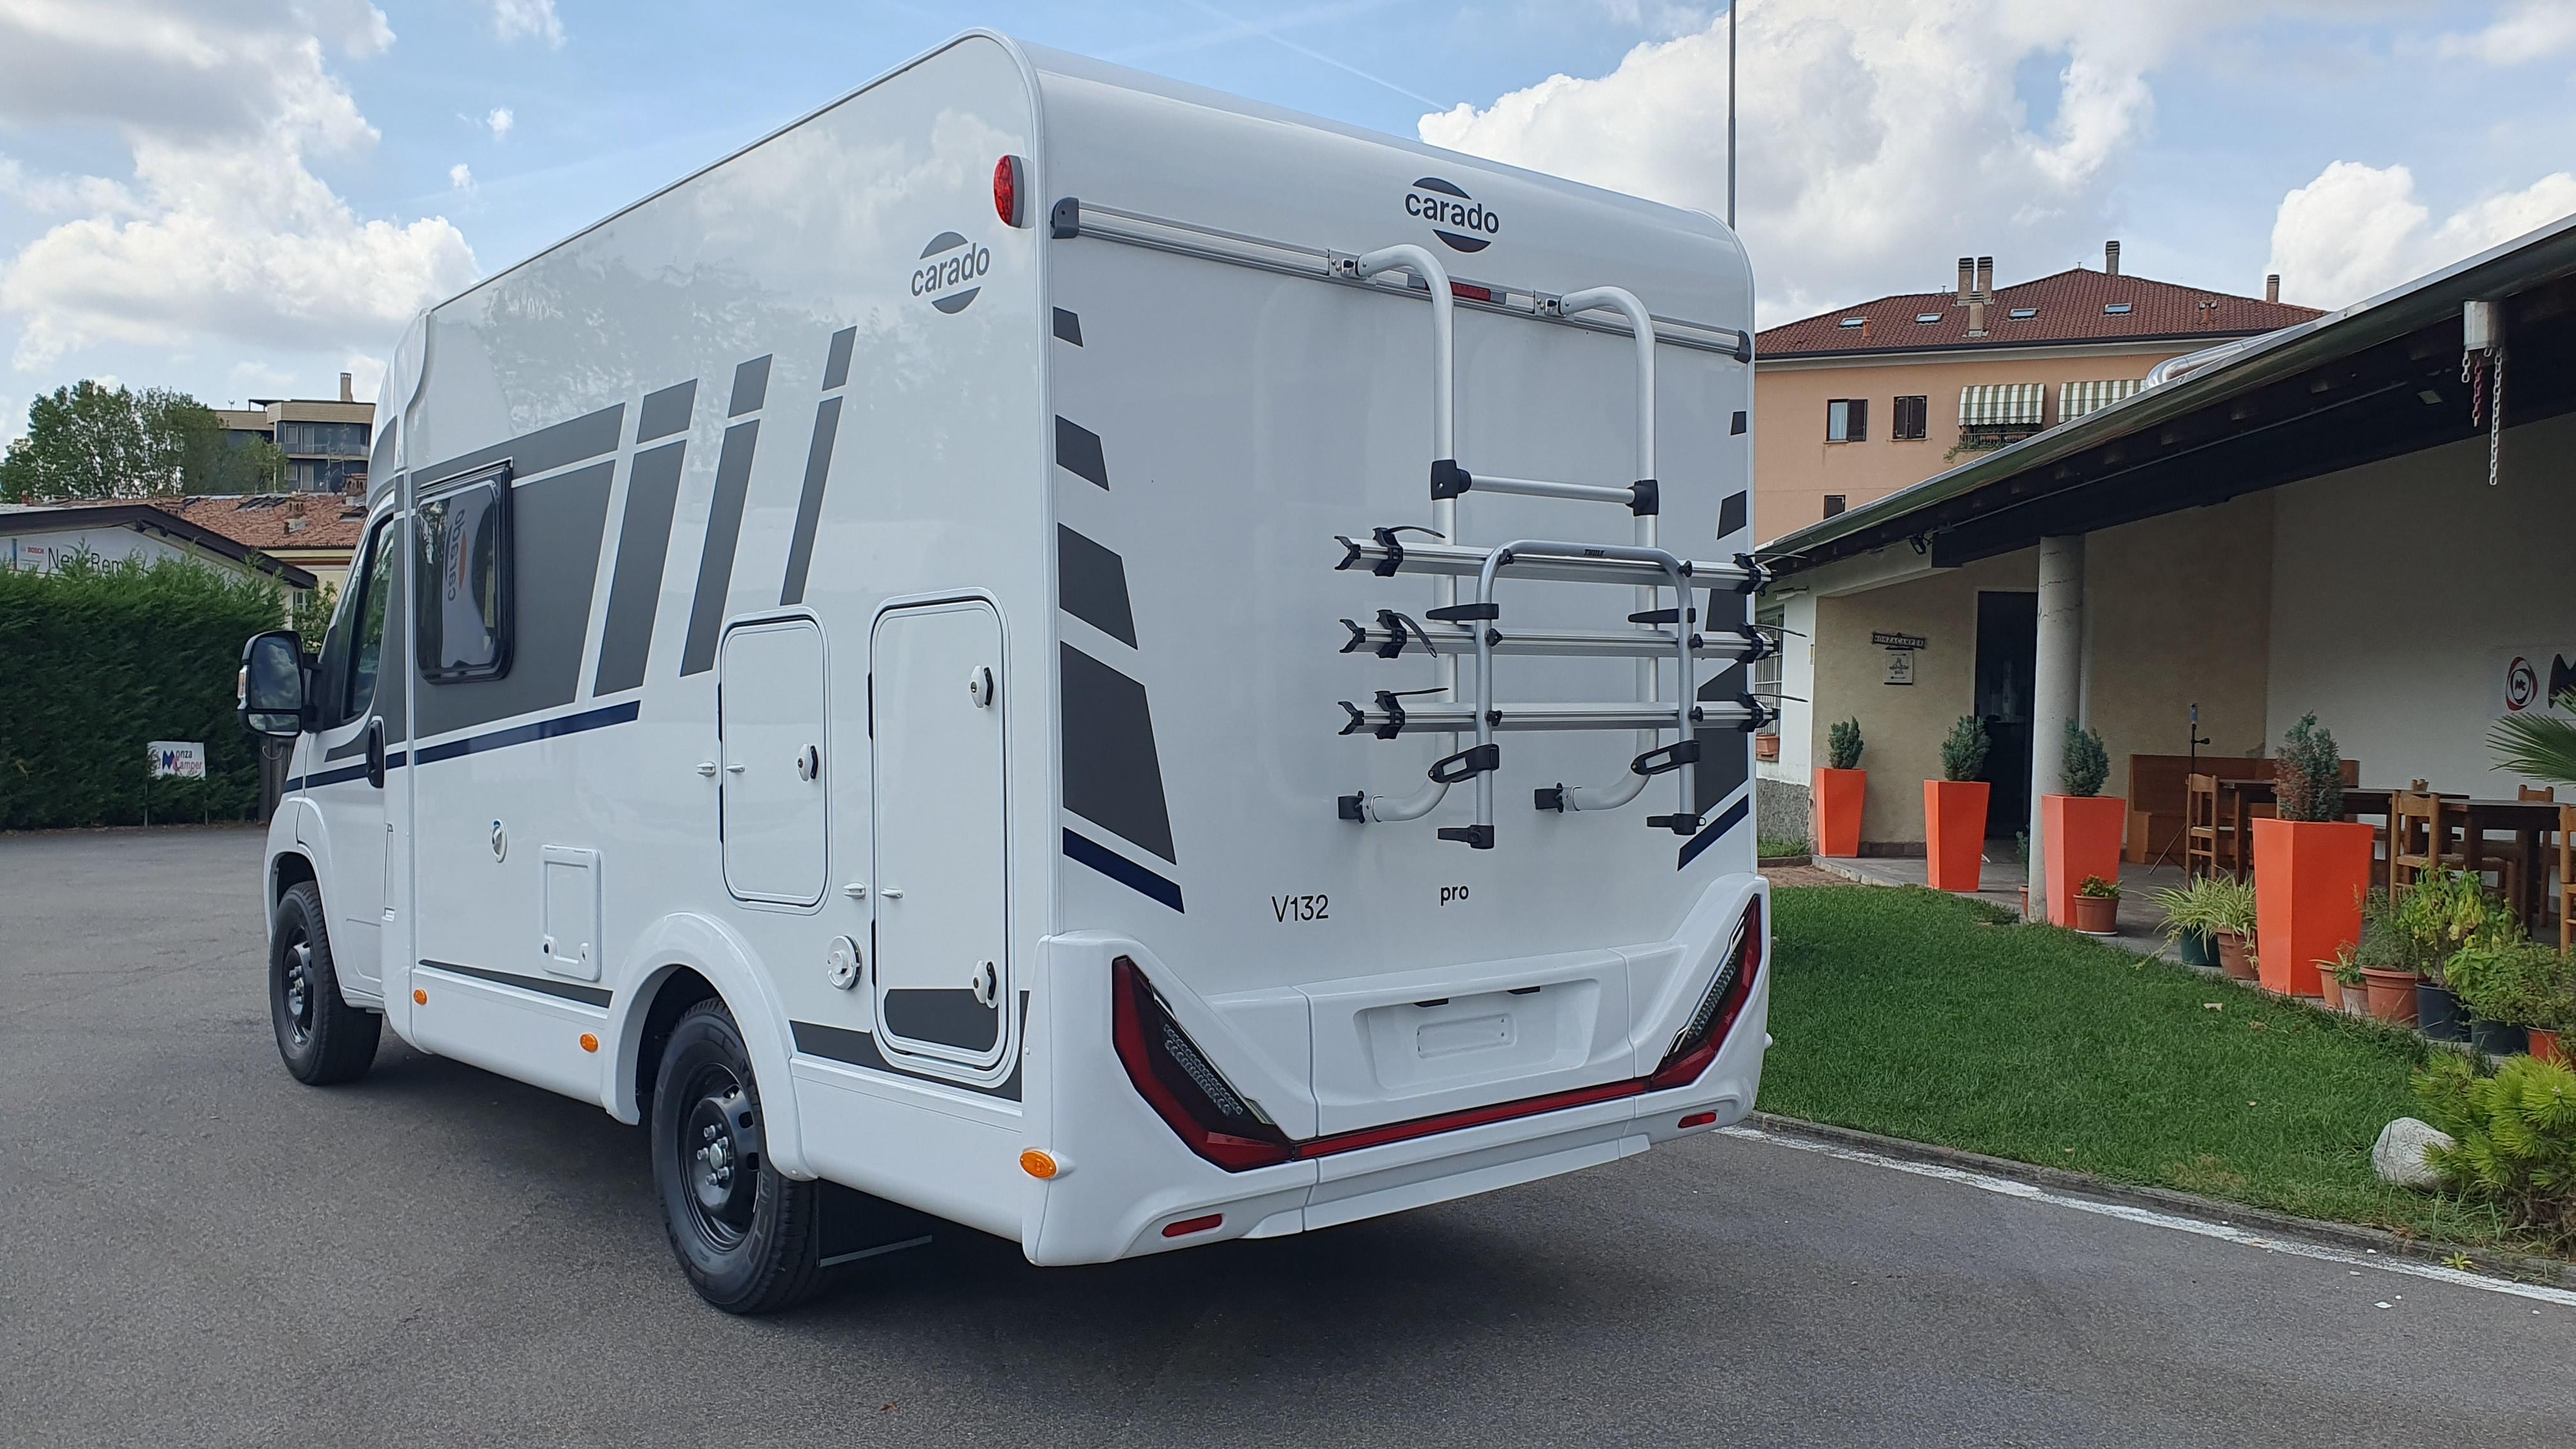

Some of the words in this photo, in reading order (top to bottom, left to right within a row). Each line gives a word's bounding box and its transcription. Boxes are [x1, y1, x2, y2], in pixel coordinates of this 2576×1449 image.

[1405, 194, 1499, 234] carado
[911, 242, 990, 296] carado
[27, 546, 44, 555] BOSCH
[162, 749, 193, 770] Monza
[172, 756, 203, 772] Camper
[1440, 885, 1469, 907] pro
[1271, 894, 1329, 923] V132
